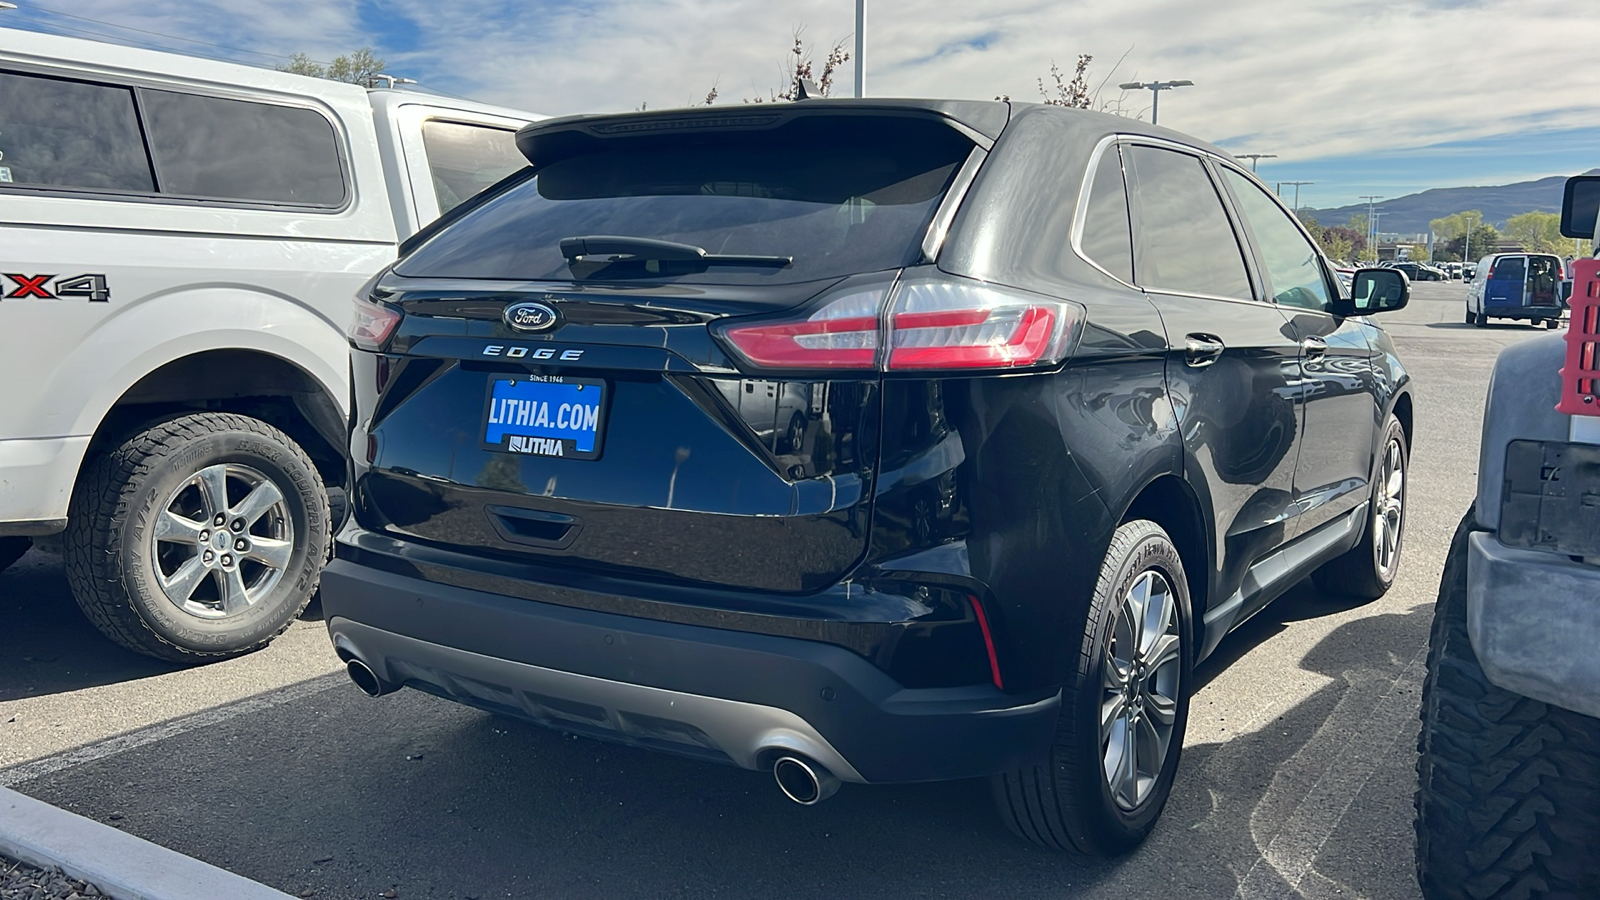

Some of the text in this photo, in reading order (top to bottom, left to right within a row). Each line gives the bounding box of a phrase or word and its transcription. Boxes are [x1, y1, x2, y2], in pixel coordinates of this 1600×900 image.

[0, 273, 110, 303] X4
[515, 307, 542, 324] Ford
[482, 344, 584, 361] EDGE
[529, 374, 564, 383] SINCE 1946
[488, 397, 600, 433] LITHIA.COM
[520, 436, 564, 457] LITHIA
[133, 486, 159, 542] A/T2
[234, 439, 320, 592] BACK COUNTRY A/T2
[131, 549, 174, 630] COUNTRY
